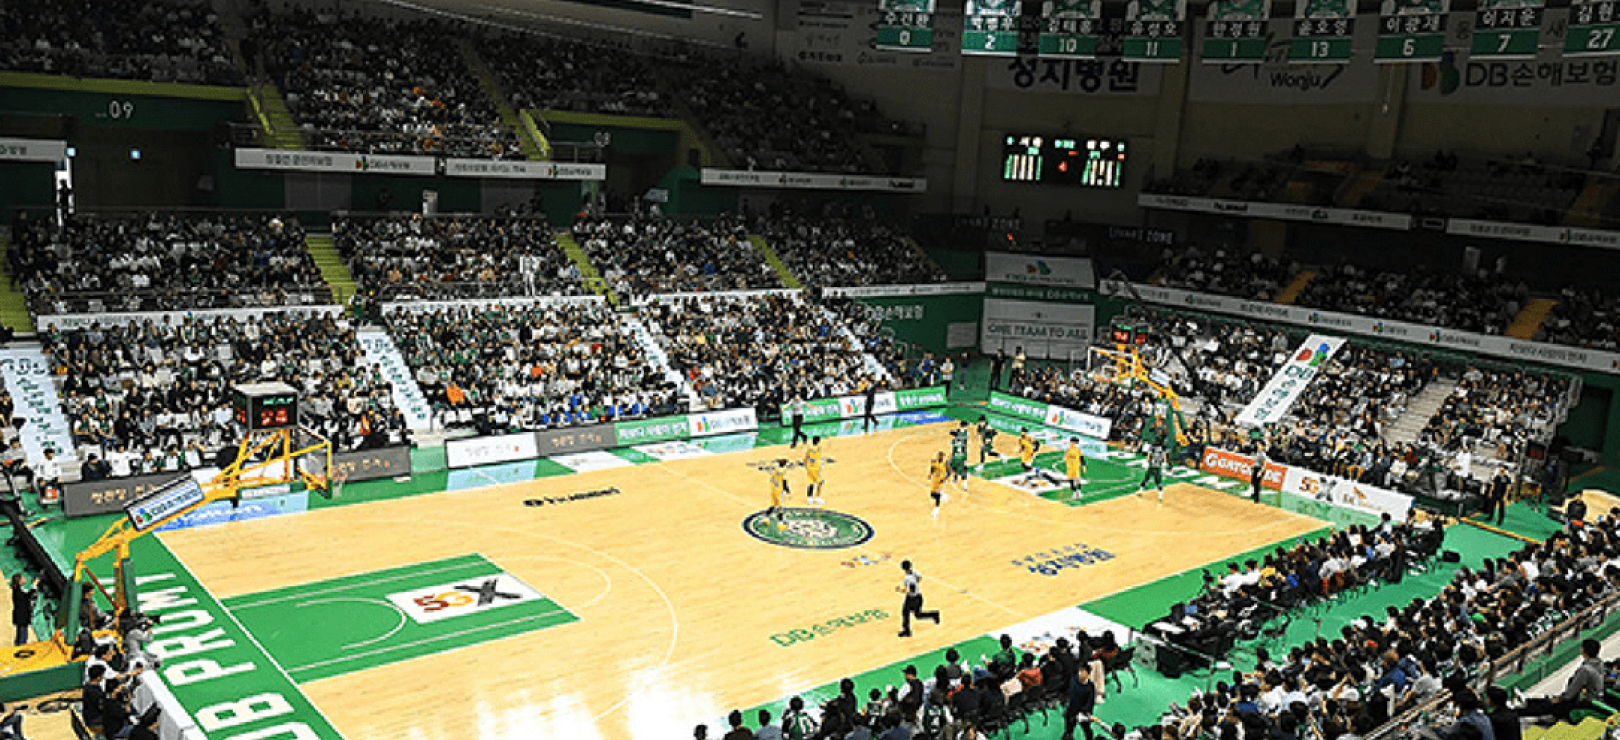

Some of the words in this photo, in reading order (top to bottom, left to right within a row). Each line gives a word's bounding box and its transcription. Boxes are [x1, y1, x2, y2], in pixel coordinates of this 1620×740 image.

[899, 30, 910, 45] 0
[984, 34, 995, 50] 2
[1059, 38, 1077, 52] 10
[1498, 34, 1512, 52] 7
[1586, 28, 1615, 48] 27
[1146, 41, 1158, 56] 11
[1230, 42, 1238, 57] 1
[1311, 41, 1330, 57] 13
[1402, 38, 1416, 56] 6
[1008, 58, 1140, 92] 성지병원
[1270, 73, 1320, 90] Wonju
[108, 100, 134, 119] 09
